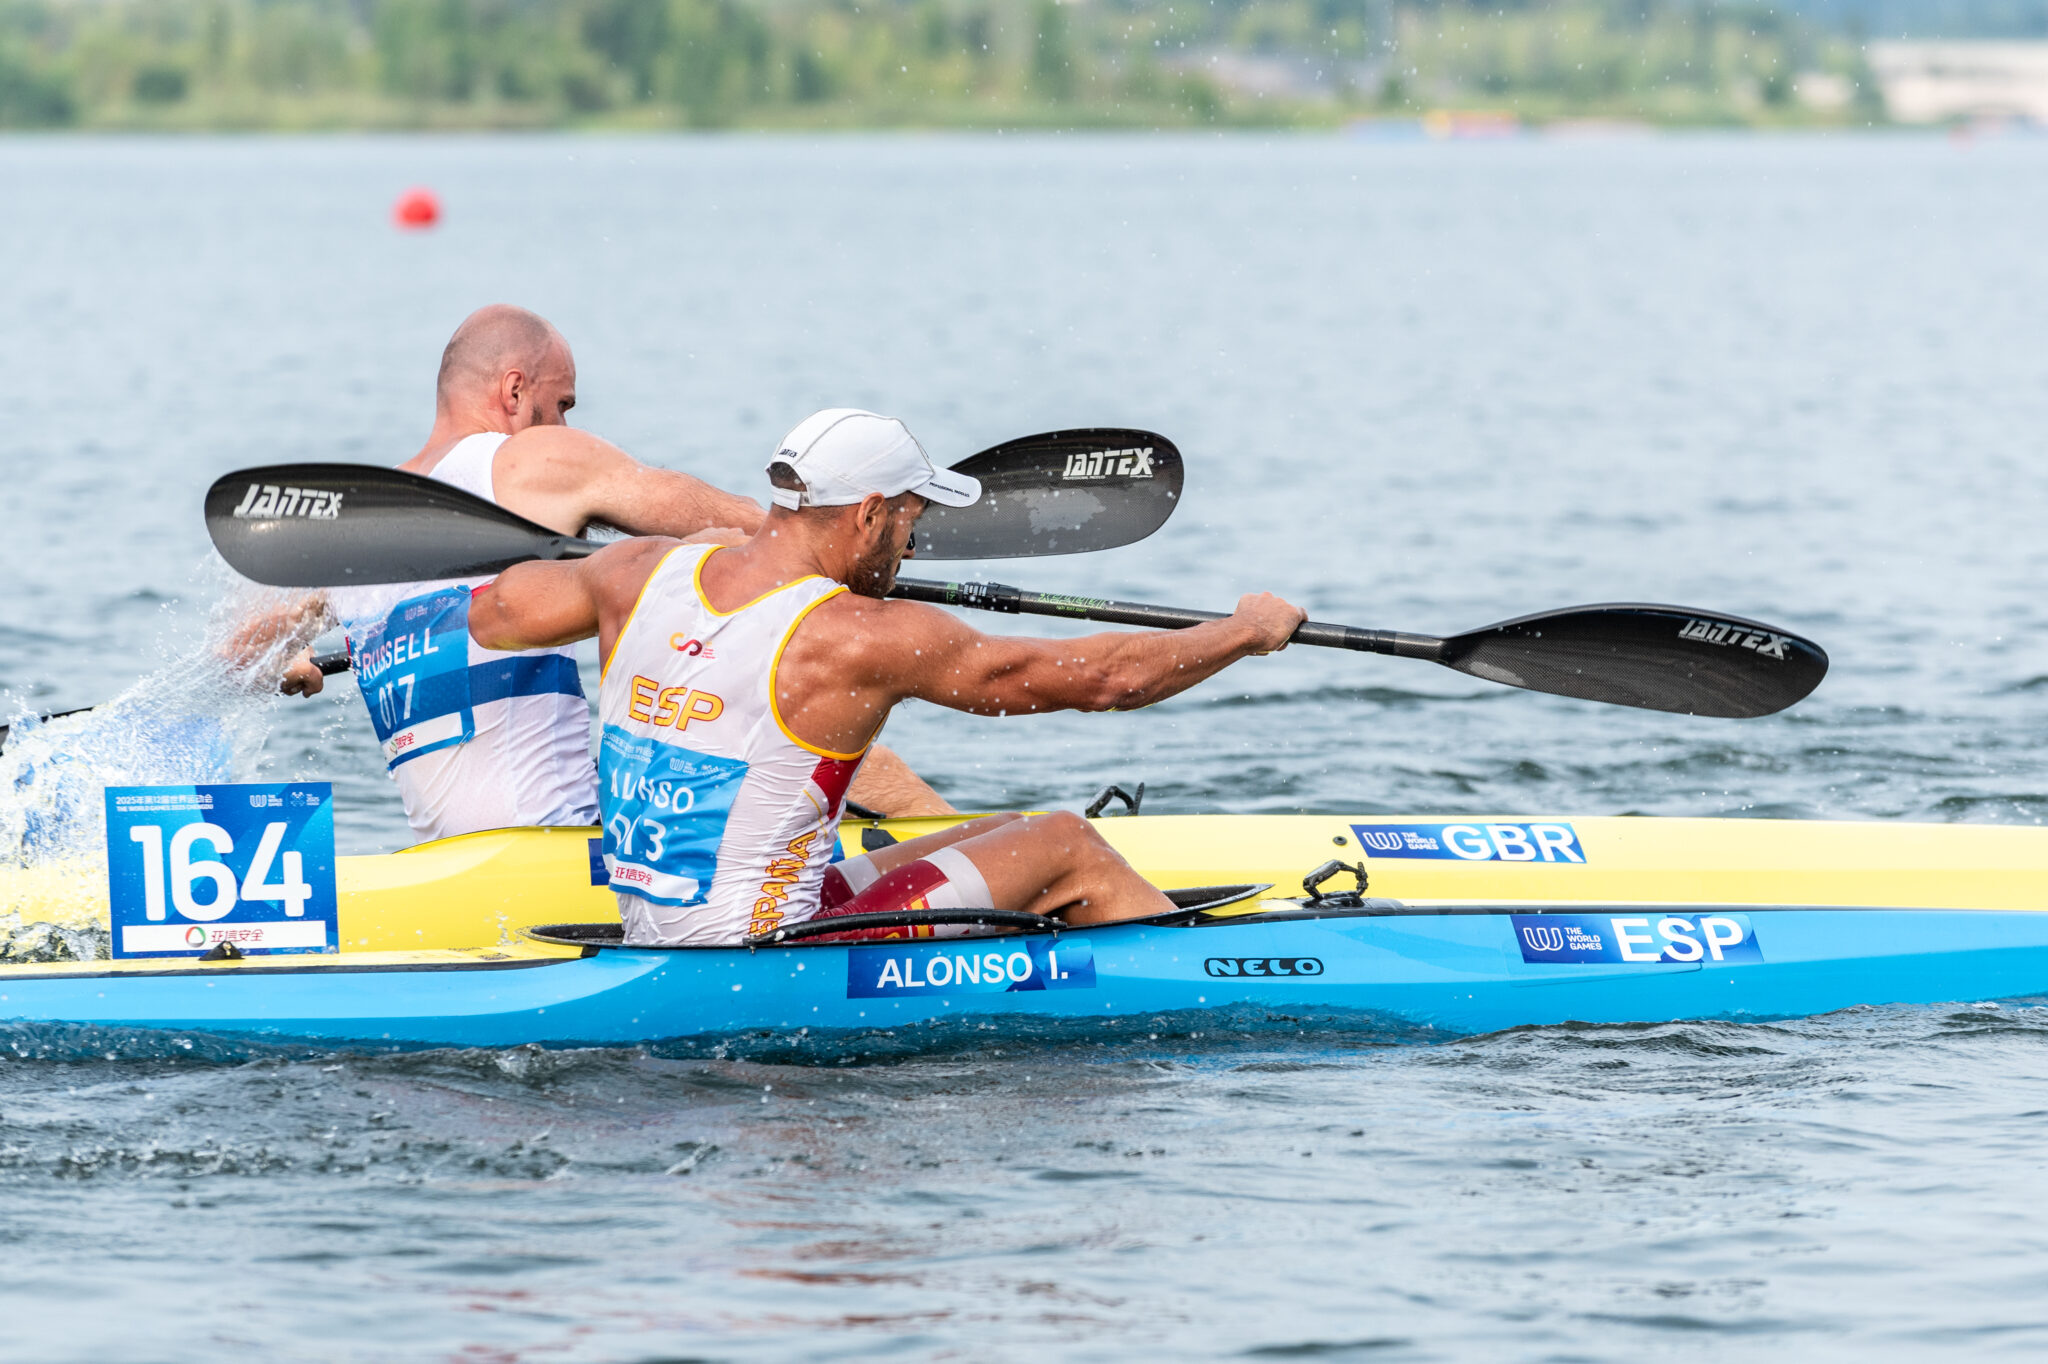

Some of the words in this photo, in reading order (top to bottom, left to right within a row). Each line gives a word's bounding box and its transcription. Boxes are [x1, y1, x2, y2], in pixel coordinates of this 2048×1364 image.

[362, 628, 439, 680] RUSSELL
[628, 675, 724, 731] ESP
[1441, 825, 1584, 862] GBR
[130, 822, 312, 921] 164
[211, 929, 264, 942] 亚信安全
[1610, 917, 1743, 962] ESP
[877, 952, 1033, 988] ALONSO
[1049, 950, 1068, 980] I.
[1207, 958, 1321, 976] NELO
